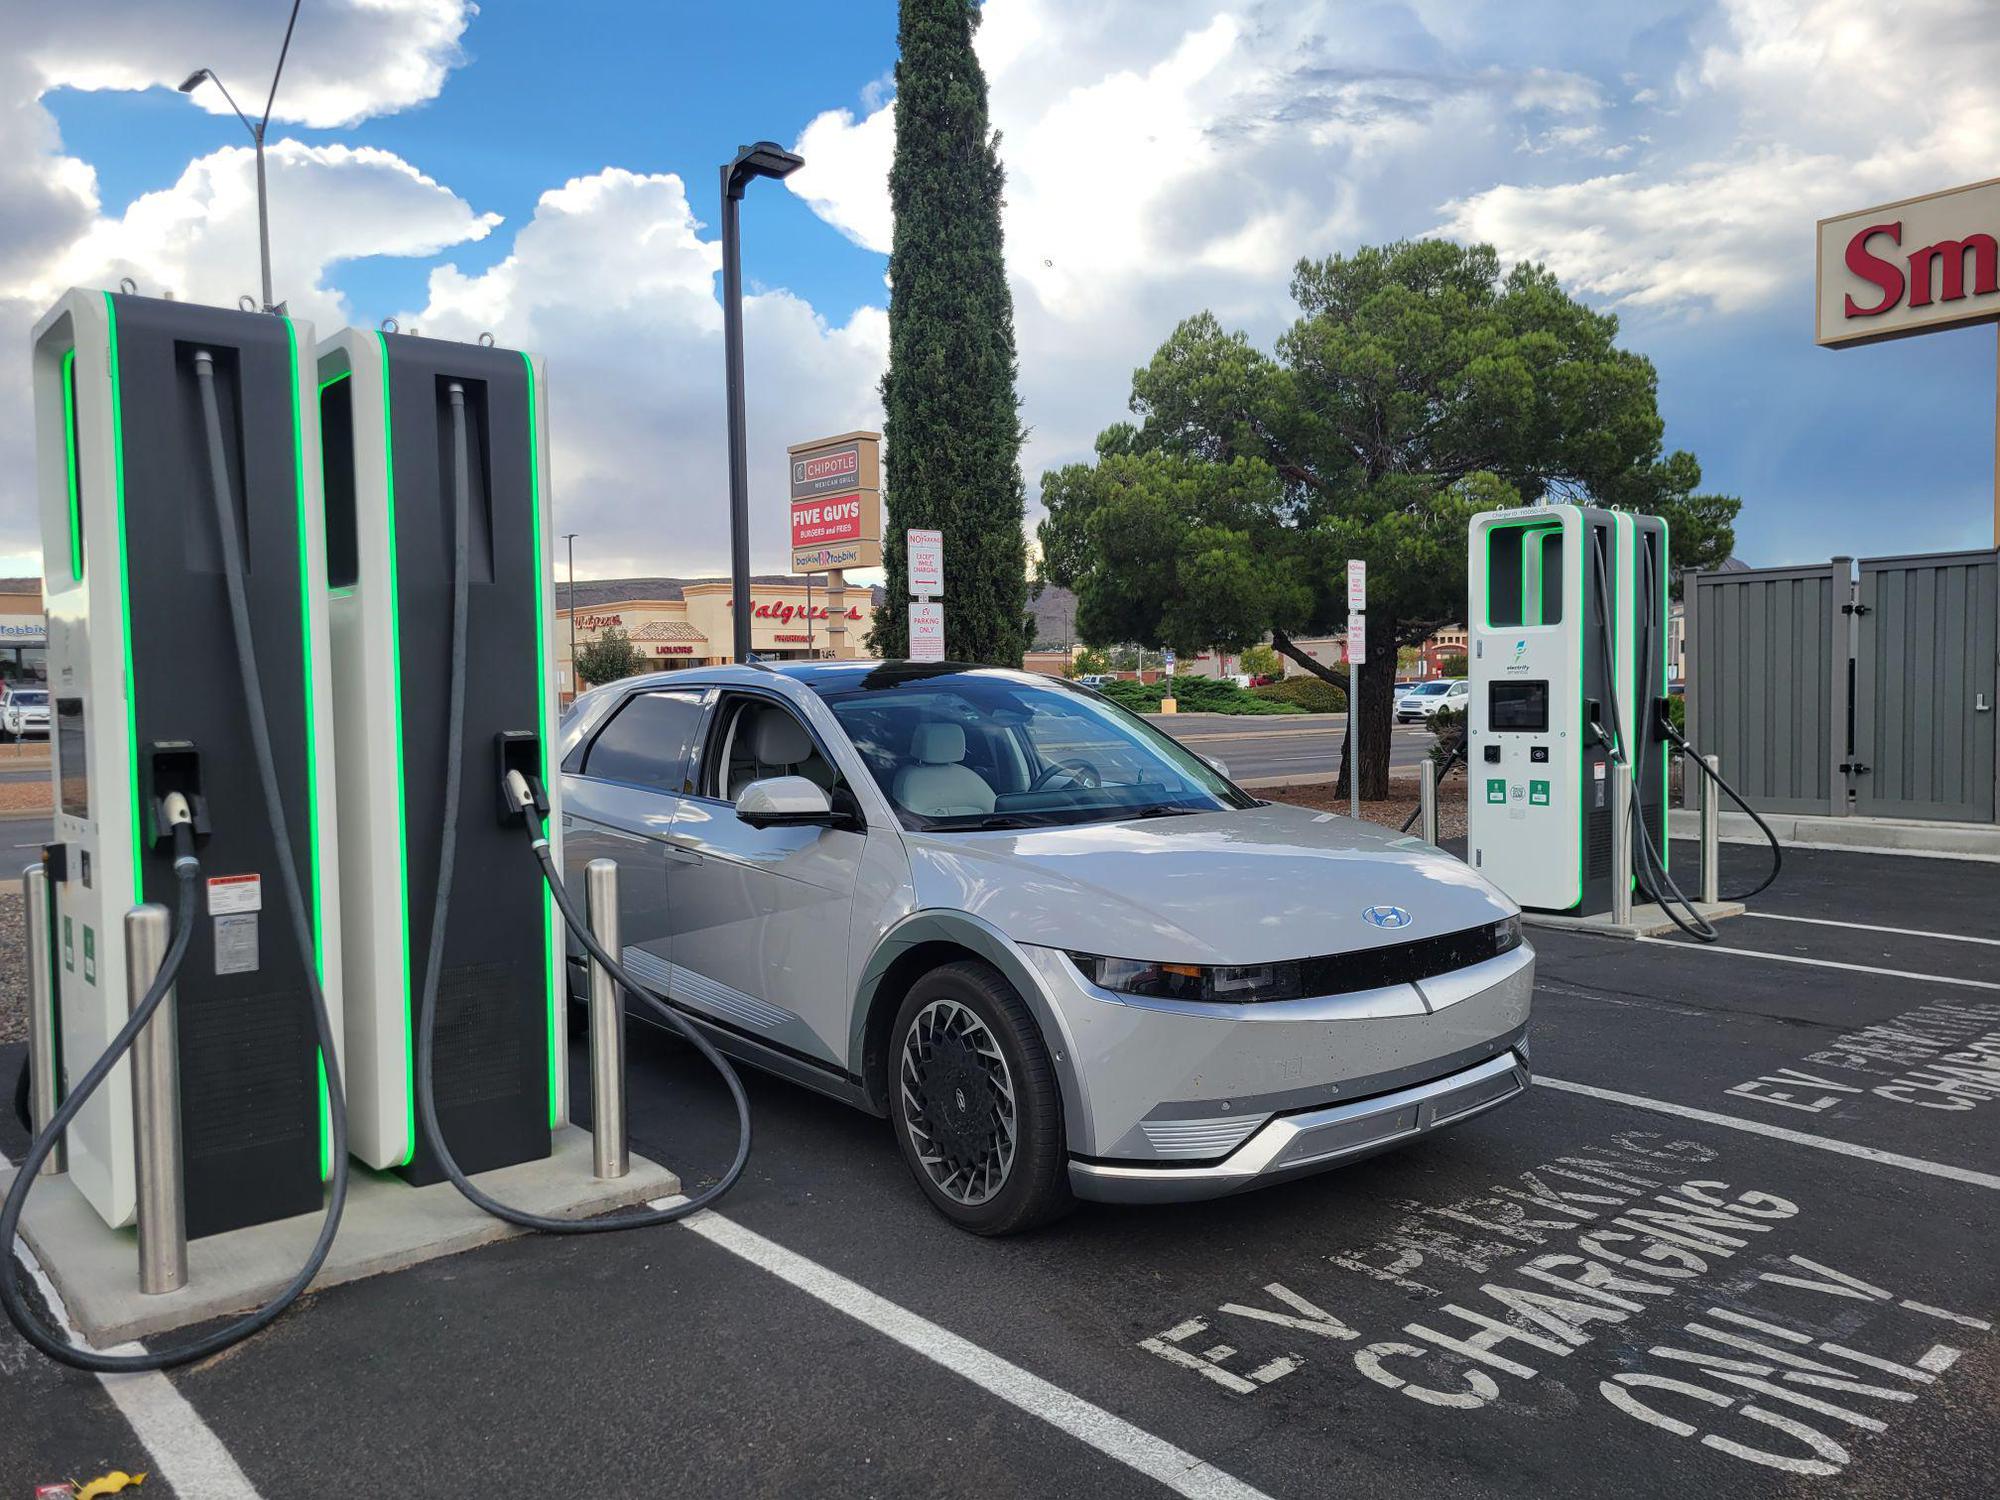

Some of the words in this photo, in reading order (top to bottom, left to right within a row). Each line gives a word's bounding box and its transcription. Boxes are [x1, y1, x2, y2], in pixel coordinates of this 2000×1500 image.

[807, 456, 855, 476] CHIPOTLE
[814, 479, 838, 488] MEXICAN
[839, 475, 855, 484] GRILL
[793, 508, 820, 527] FIVE
[824, 501, 859, 521] GUYS
[800, 527, 825, 539] BURGERS
[836, 522, 851, 533] FRIES
[656, 646, 693, 655] LIQUORS
[1723, 1067, 1864, 1112] EV
[1353, 1180, 1799, 1409] CHARGING
[1136, 1282, 1362, 1394] EV
[1599, 1254, 1992, 1476] ONLY
